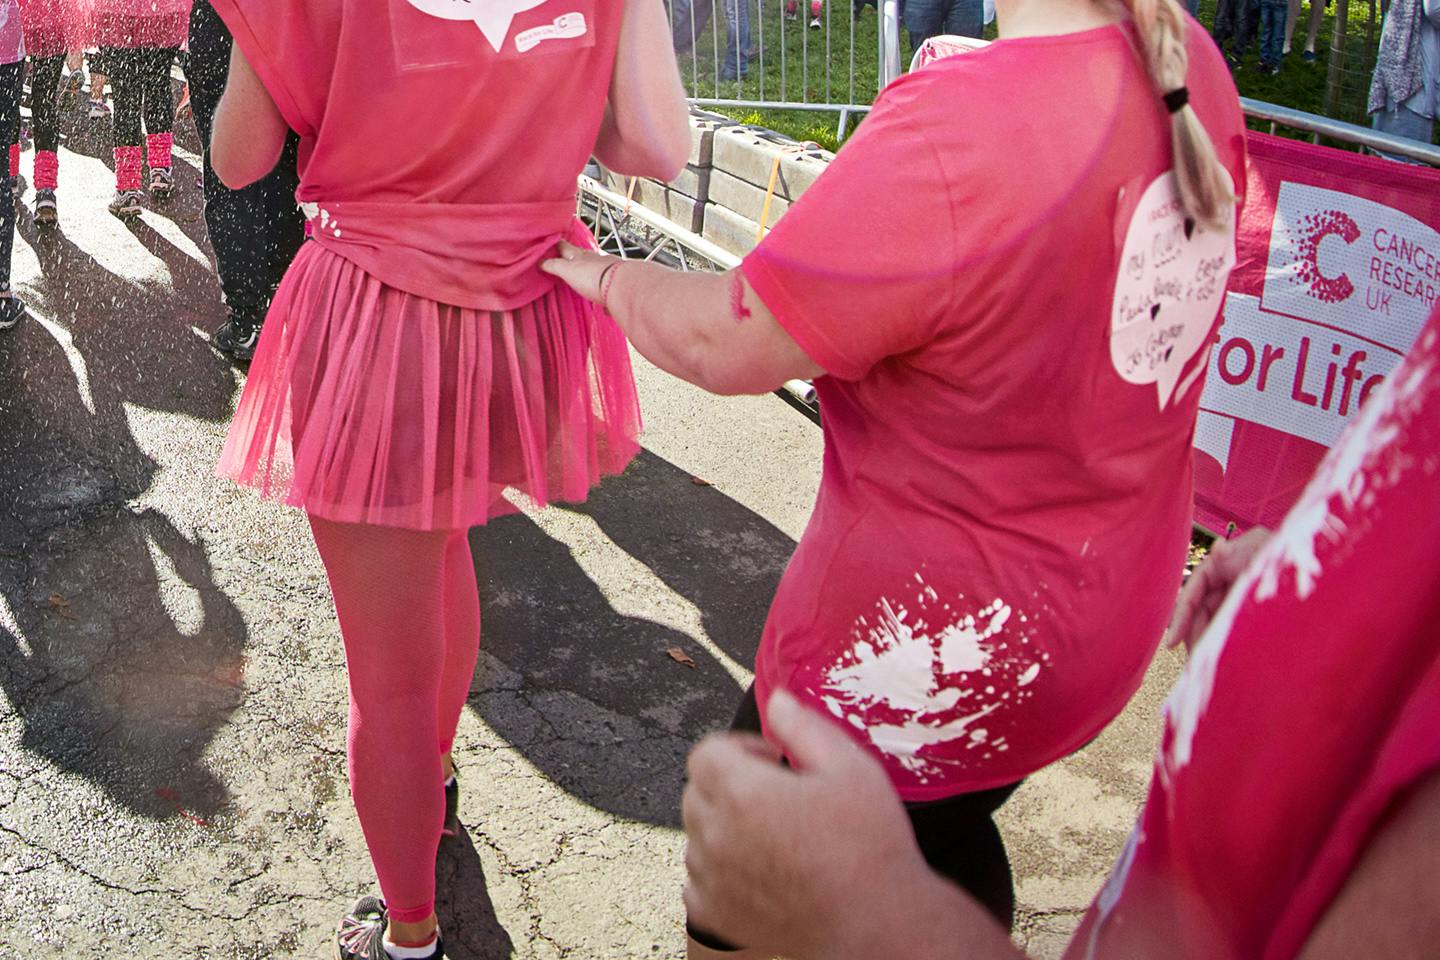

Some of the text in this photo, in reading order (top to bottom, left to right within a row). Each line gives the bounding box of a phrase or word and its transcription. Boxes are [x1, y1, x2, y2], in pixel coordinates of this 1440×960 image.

[1366, 286, 1392, 316] UK
[1369, 255, 1436, 311] RESEAR
[1213, 314, 1285, 392] or
